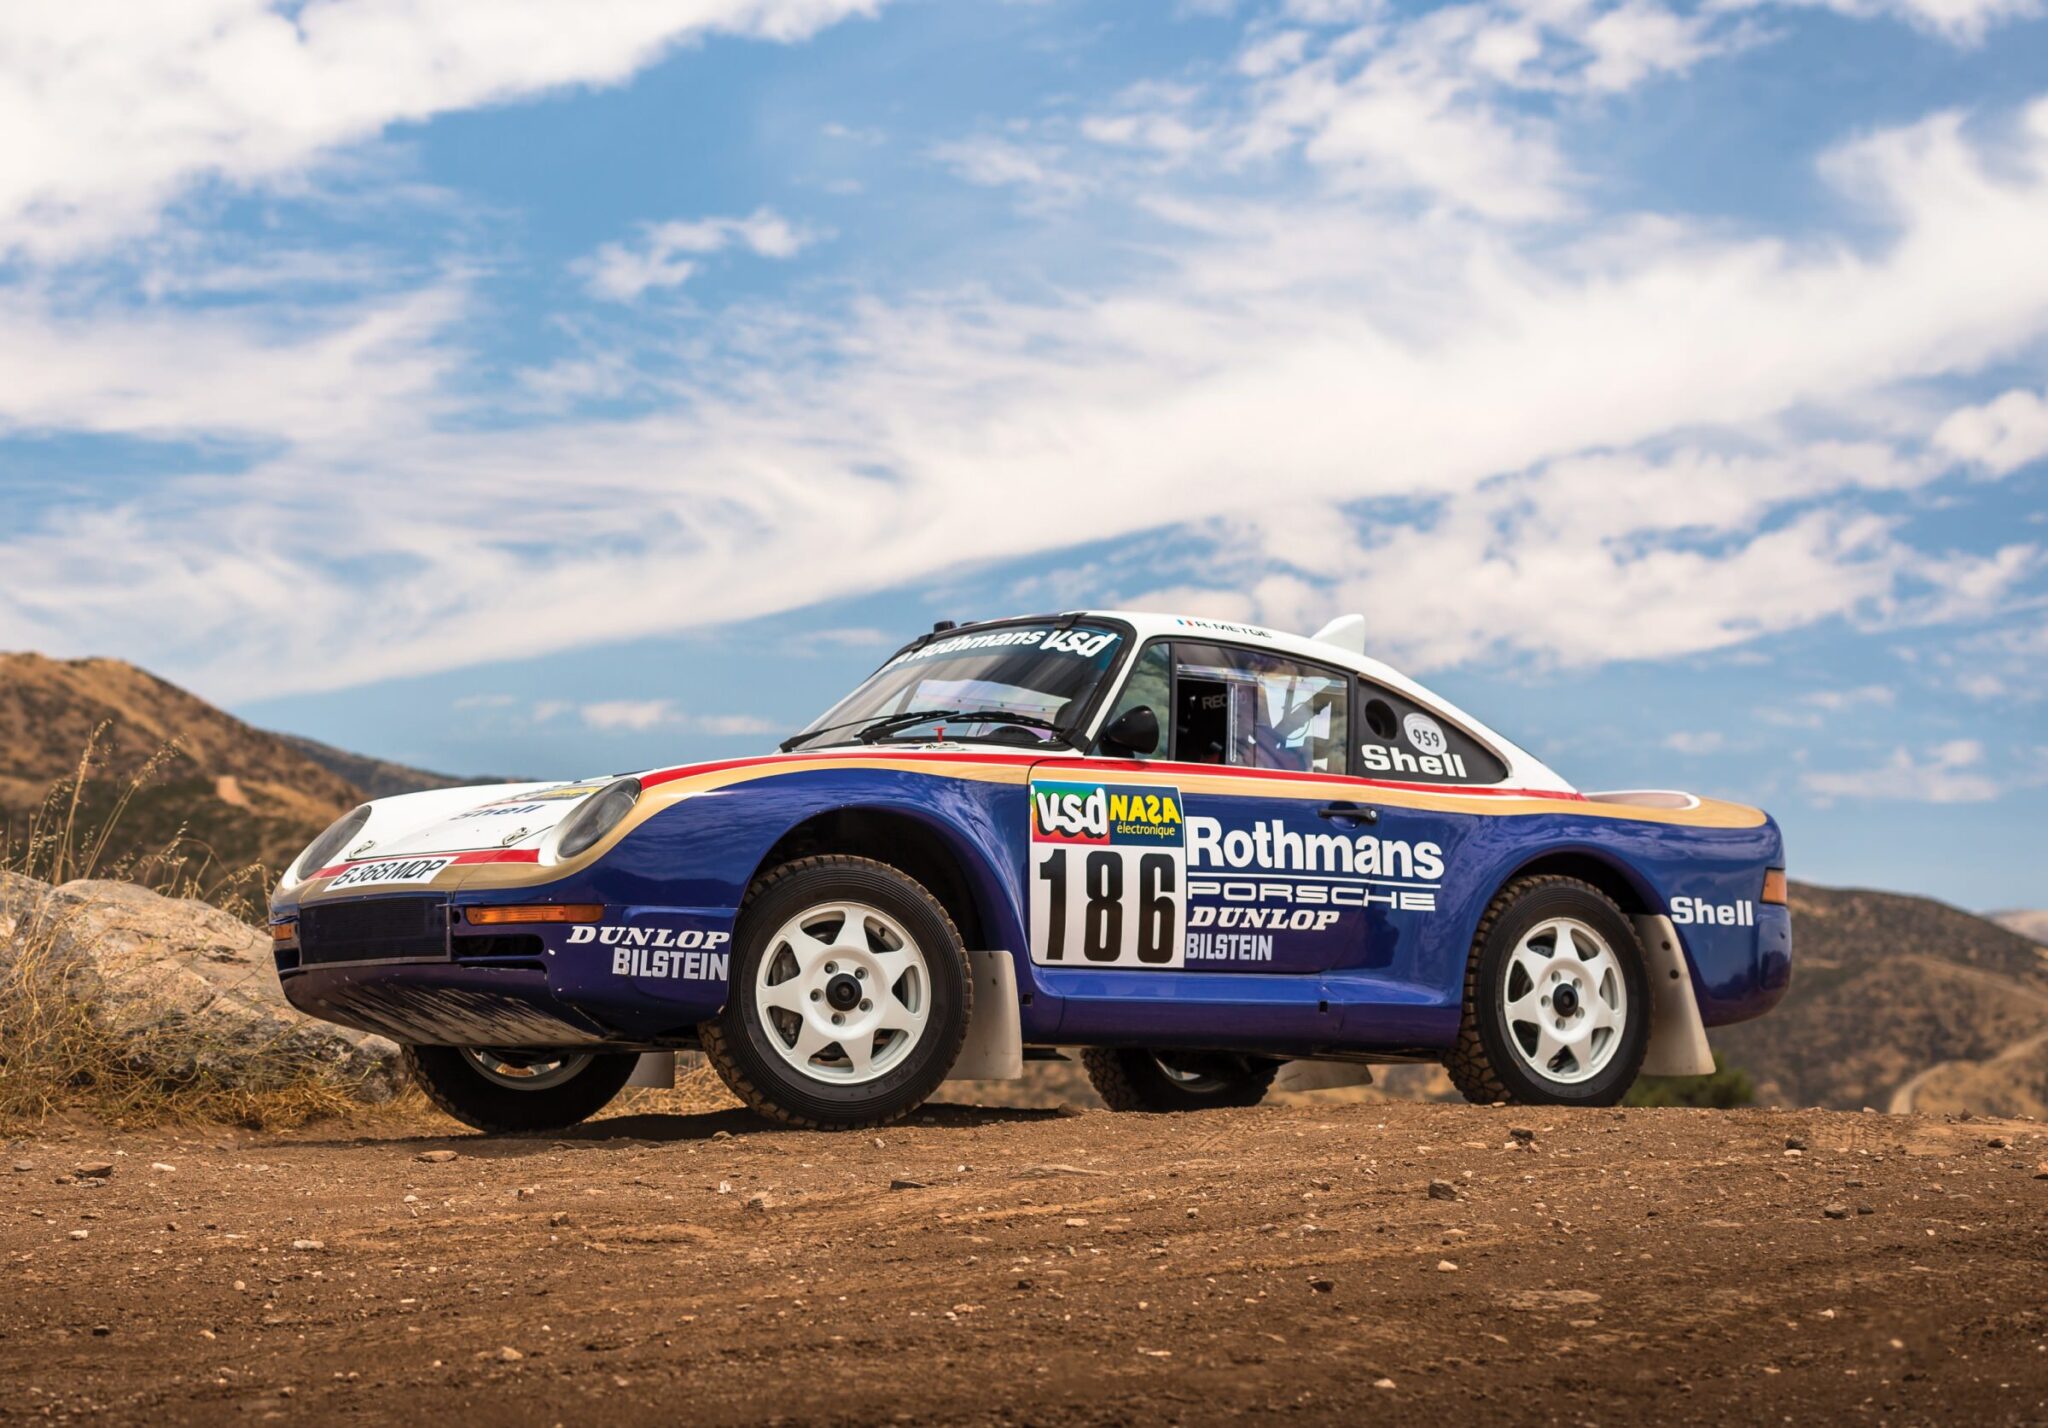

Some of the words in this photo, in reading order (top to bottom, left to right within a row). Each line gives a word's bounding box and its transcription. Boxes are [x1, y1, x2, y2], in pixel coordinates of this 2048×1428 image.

[907, 630, 1047, 662] Rothmans
[1413, 728, 1441, 748] 959
[1361, 744, 1467, 778] Shell
[448, 804, 546, 821] Shell
[1117, 821, 1176, 839] électronique
[1184, 815, 1446, 880] Rothmans
[1039, 848, 1176, 965] 186
[1186, 881, 1437, 912] PORSCHE
[1670, 895, 1754, 927] Shell
[1187, 905, 1340, 931] DUNLOP
[565, 925, 731, 951] DUNLOP
[1185, 932, 1273, 962] BILSTEIN
[611, 945, 730, 982] BILSTEIN
